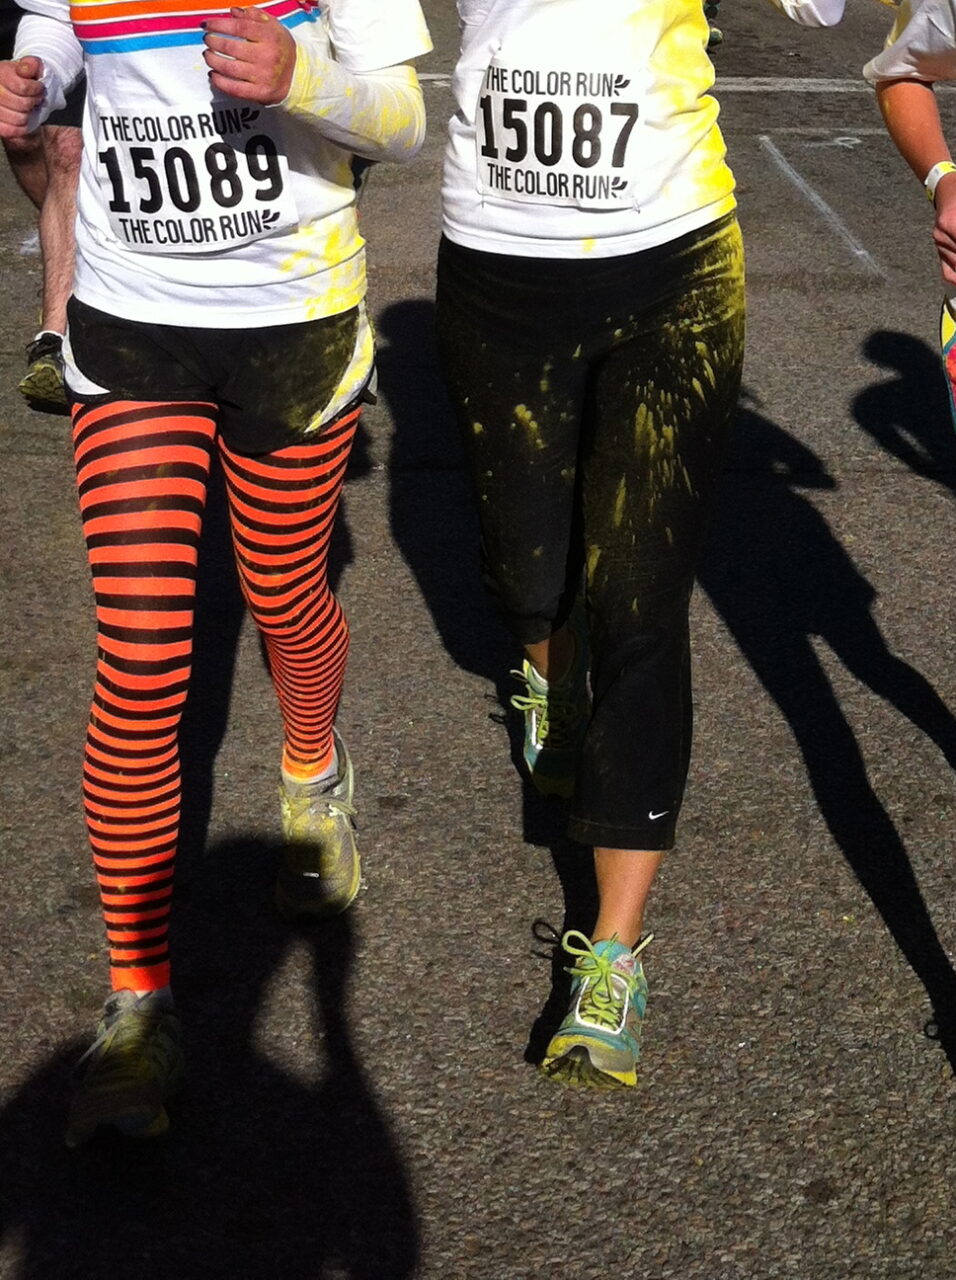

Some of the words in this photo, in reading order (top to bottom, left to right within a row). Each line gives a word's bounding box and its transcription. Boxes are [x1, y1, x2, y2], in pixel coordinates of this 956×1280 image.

[487, 65, 508, 93] THE
[512, 70, 571, 96] COLOR
[576, 72, 613, 97] RUN
[100, 116, 133, 142] THE
[134, 115, 196, 142] COLOR
[197, 108, 242, 138] RUN
[480, 95, 639, 169] 15087
[99, 134, 283, 214] 15089
[487, 163, 512, 191] THE
[514, 168, 569, 197] COLOR
[573, 174, 609, 199] RUN
[118, 219, 153, 244] THE
[153, 217, 218, 245] COLOR
[219, 209, 262, 241] RUN
